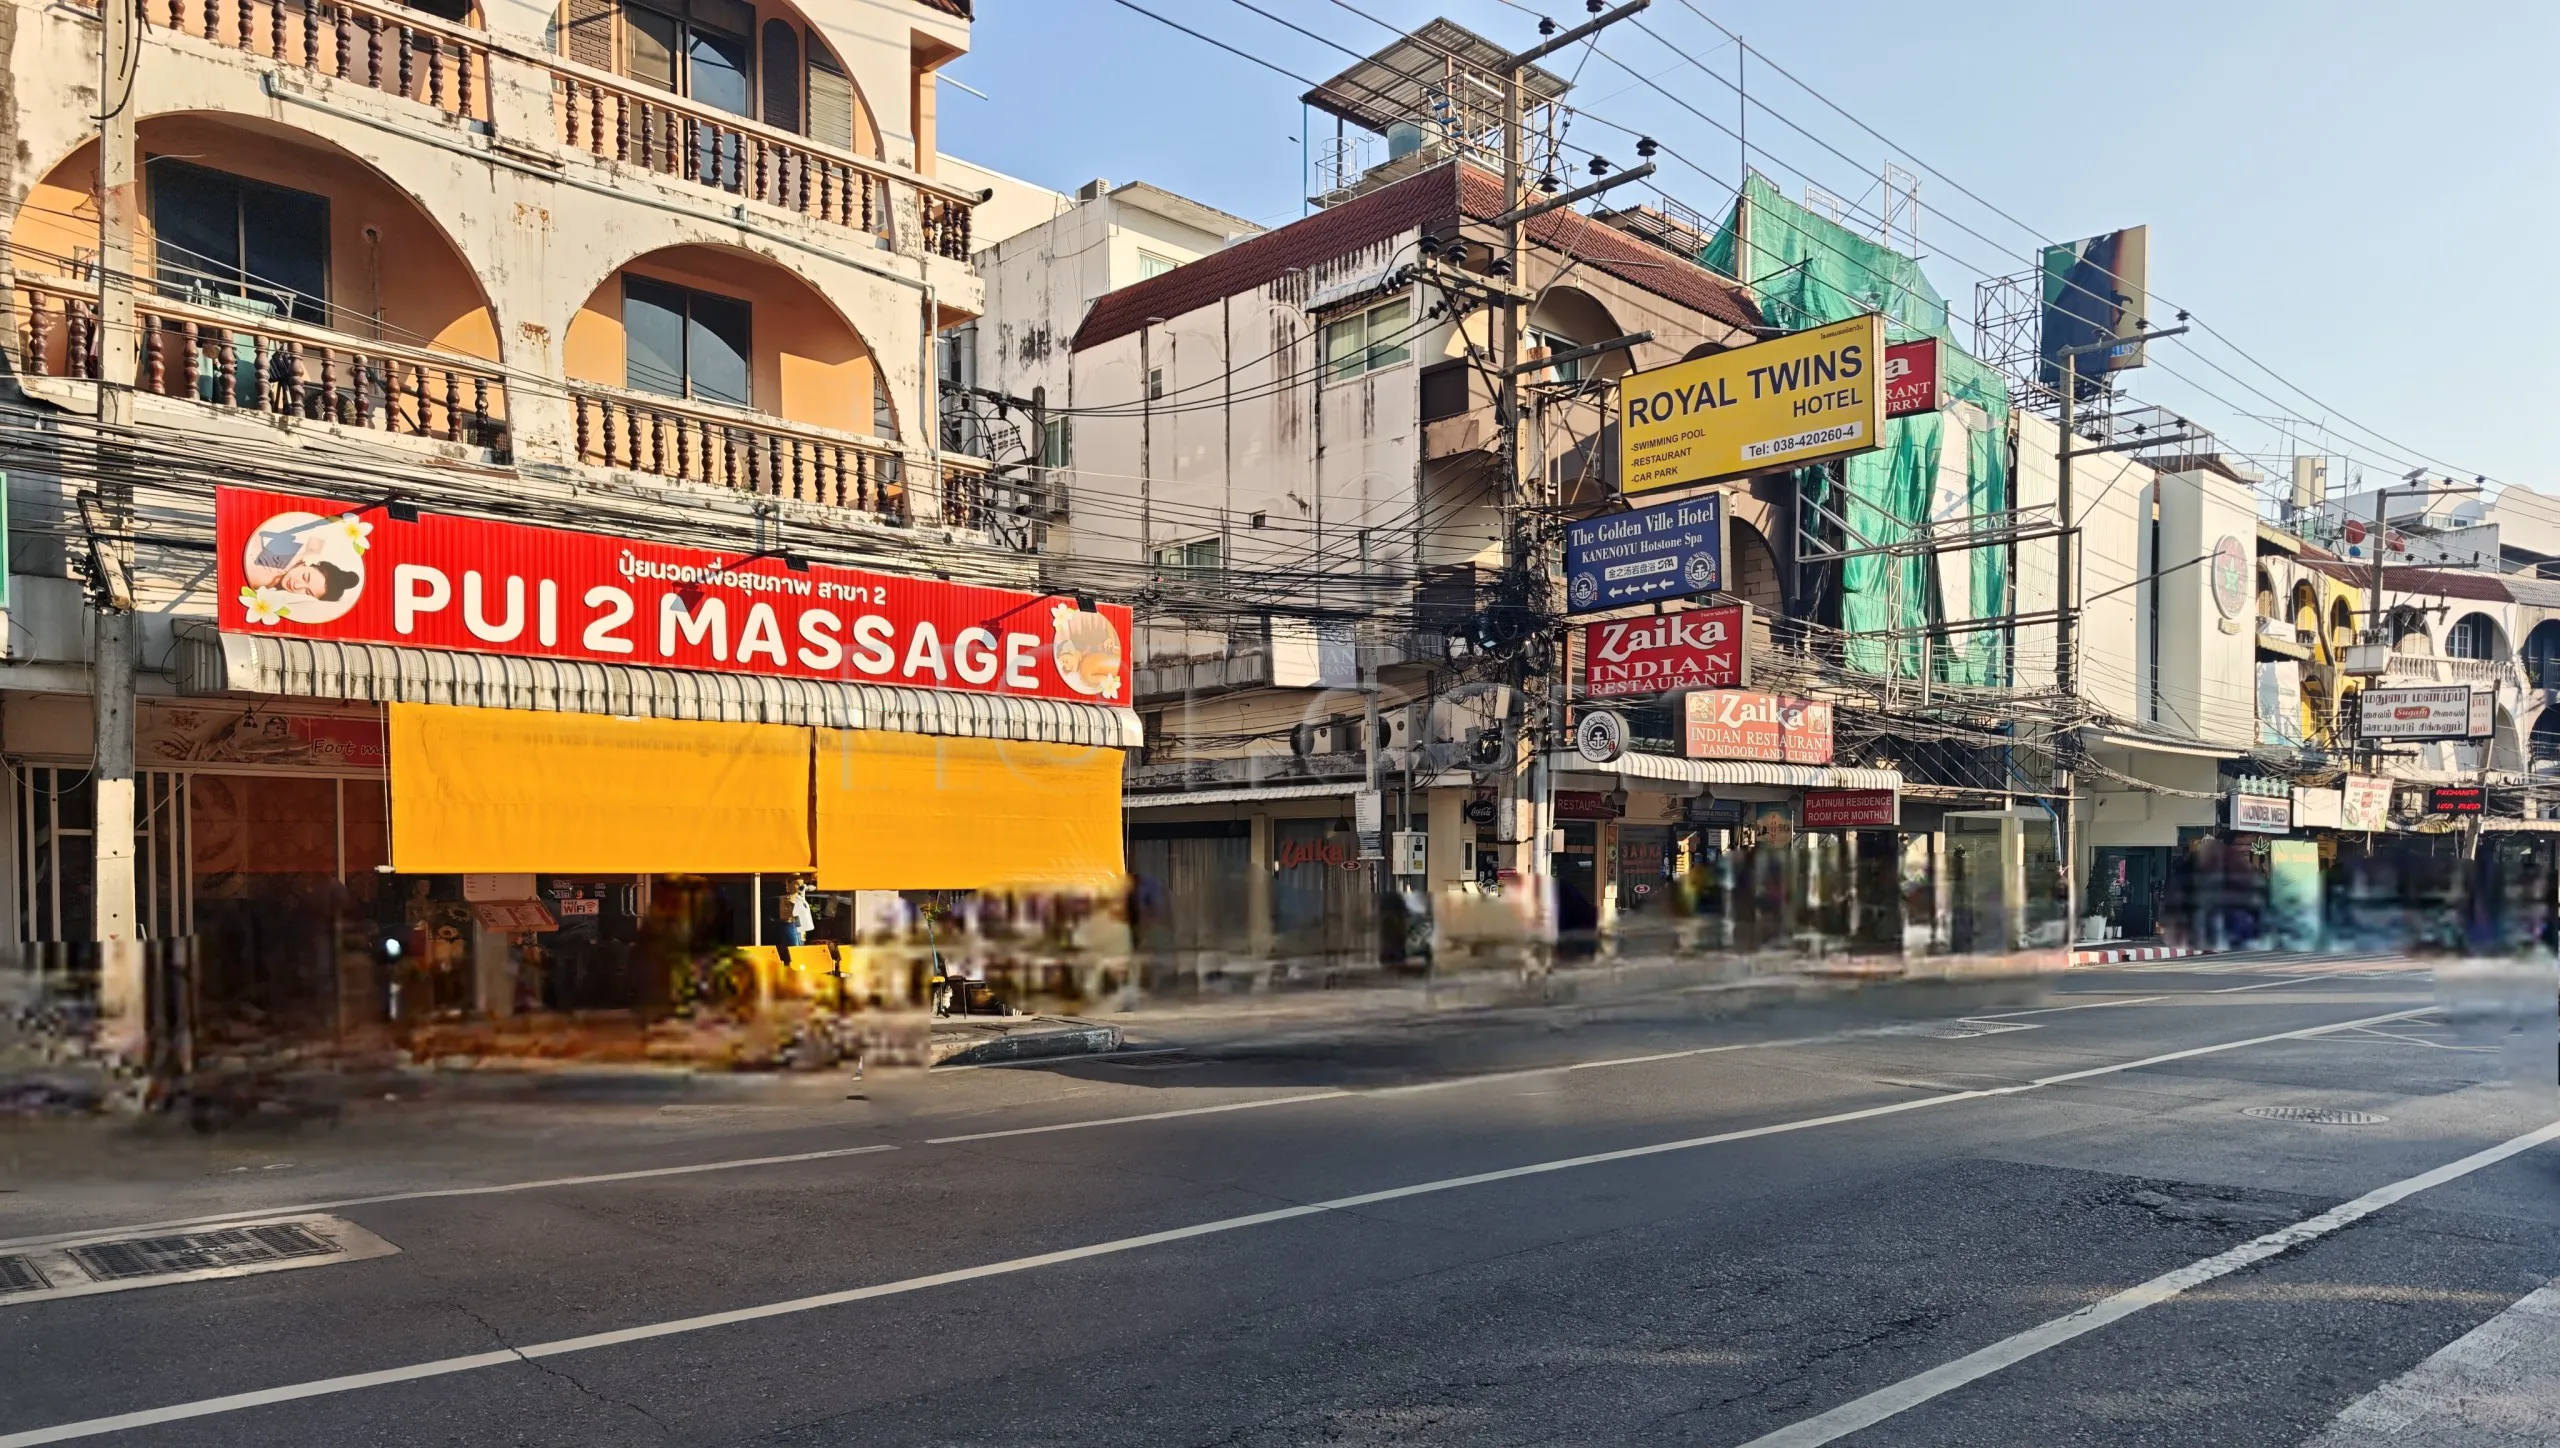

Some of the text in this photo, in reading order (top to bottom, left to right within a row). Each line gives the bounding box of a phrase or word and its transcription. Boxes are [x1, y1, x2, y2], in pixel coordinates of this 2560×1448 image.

[1628, 345, 1864, 428] ROYAL TWINS
[1792, 387, 1863, 418] HOTEL
[1681, 428, 1706, 444] POOL
[1749, 426, 1855, 458] Tel: 038-420260-4
[1655, 466, 1678, 480] PARK
[1571, 503, 1714, 547] The Golden Ville Hotel
[1582, 532, 1703, 564] KANENOYU Hotstone Spa
[618, 549, 887, 606] ปุ๋ยนวดเพื่อสุขภาพ สาขา 2
[1657, 558, 1675, 570] SPA
[394, 563, 1041, 692] PUI 2 MASSAGE
[1597, 615, 1729, 662] Zaika
[1591, 653, 1732, 683] INDIAN
[1590, 671, 1734, 697] RESTAURANT
[1719, 694, 1805, 731] Zaika
[313, 738, 357, 755] Foot
[1691, 727, 1830, 751] INDIAN RESTAURANT
[1701, 743, 1822, 763] TANDOORI AND CURRY
[1806, 795, 1892, 809] PLATINUM RESIDENCE
[1808, 809, 1889, 823] ROOM FOR MONTHLY
[2241, 804, 2288, 823] WONDER WEED
[1281, 838, 1344, 869] Zaika
